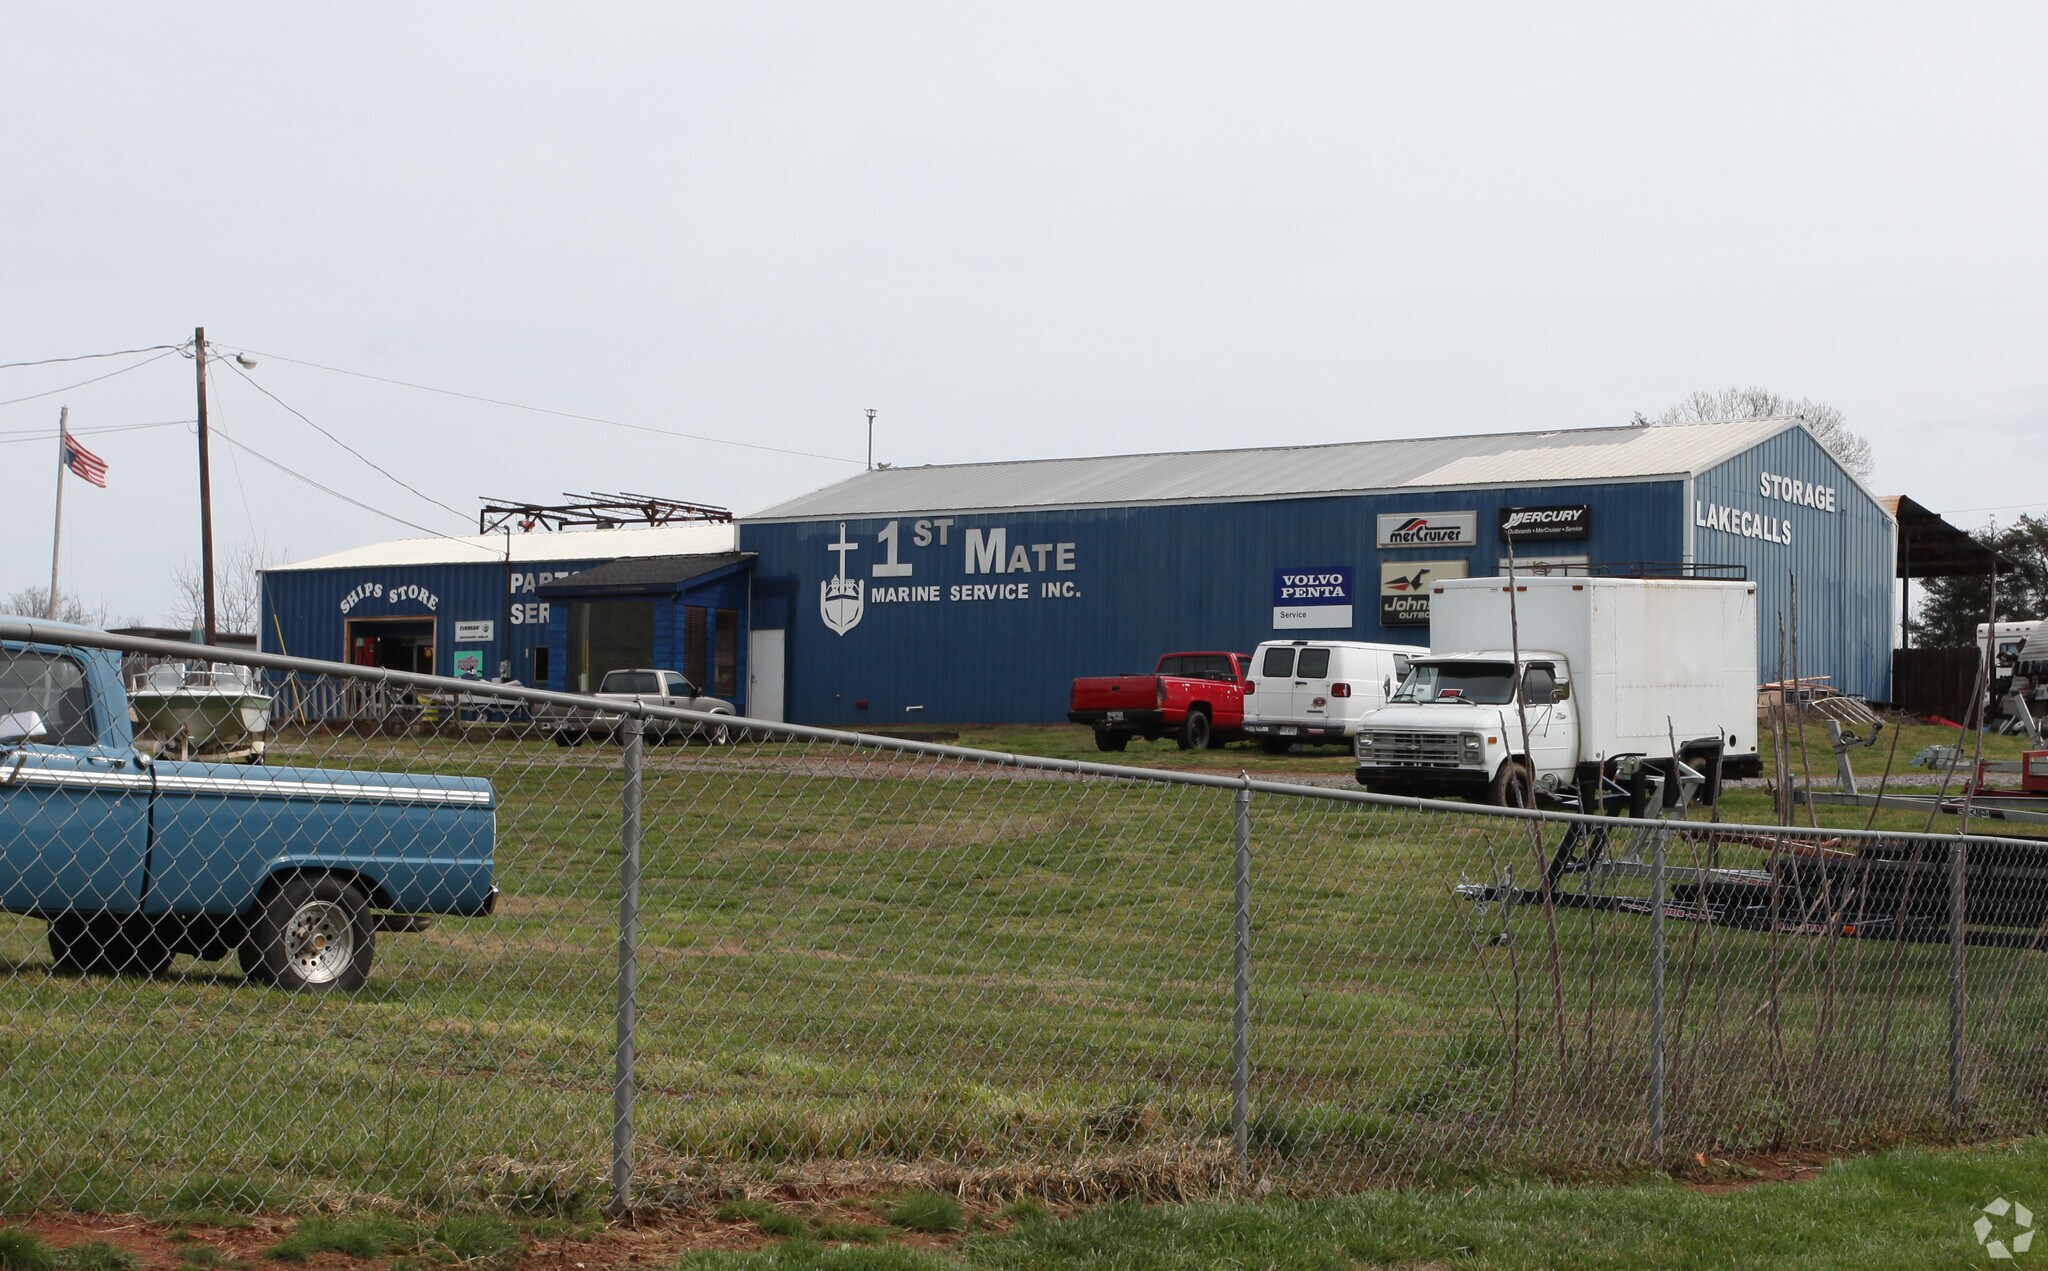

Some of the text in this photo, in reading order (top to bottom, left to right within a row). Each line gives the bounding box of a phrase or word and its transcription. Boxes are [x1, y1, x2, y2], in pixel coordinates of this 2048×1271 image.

[1759, 471, 1836, 513] STORAGE
[1502, 509, 1583, 529] MERCURY
[1695, 500, 1792, 546] LAKECALLS
[1390, 525, 1461, 543] merCruiser
[510, 571, 580, 594] PAR
[1282, 573, 1344, 587] VOLVO
[340, 582, 439, 615] SHIPS STORE
[871, 581, 1081, 604] MARINE SERVICE INC.
[1280, 585, 1346, 599] PENTA
[1279, 610, 1307, 619] Service
